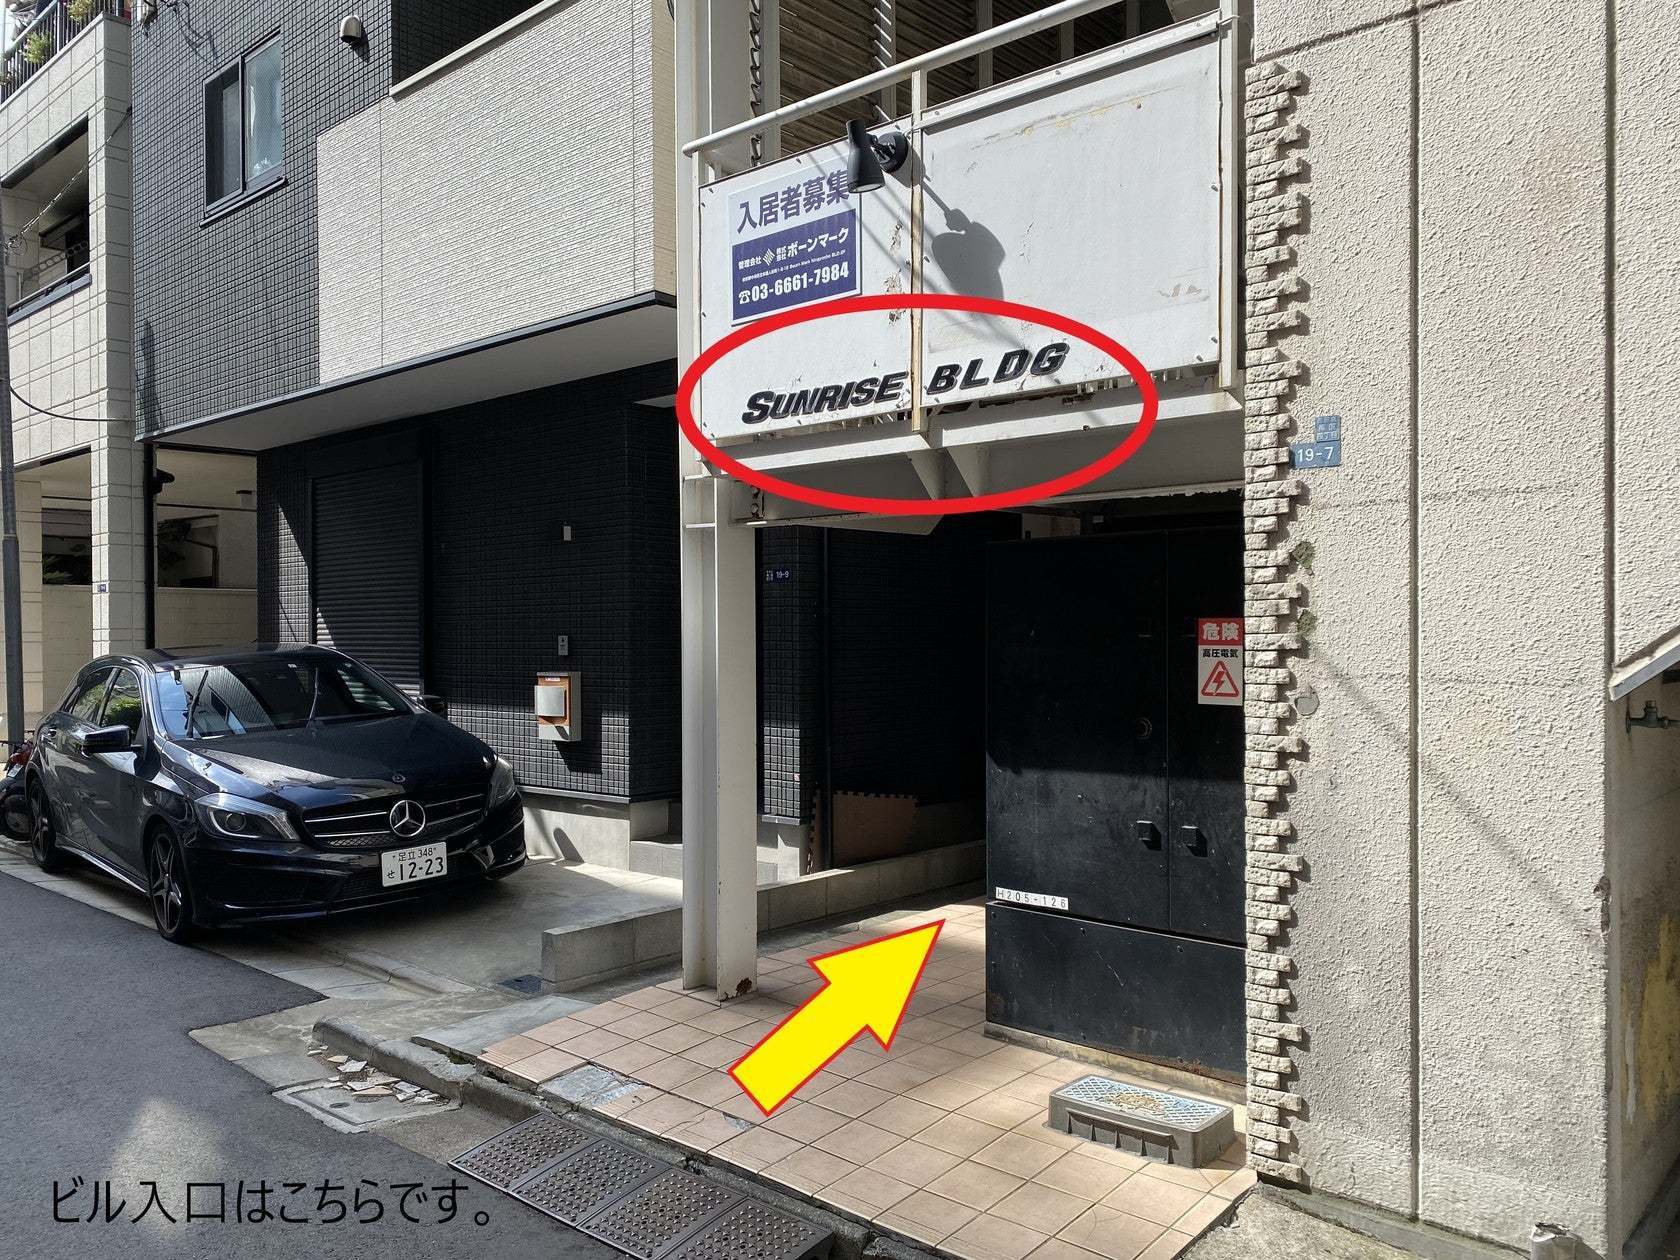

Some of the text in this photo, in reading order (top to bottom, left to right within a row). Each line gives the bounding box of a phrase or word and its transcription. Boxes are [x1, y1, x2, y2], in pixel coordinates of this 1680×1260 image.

[737, 170, 849, 234] 入居者募集
[751, 261, 849, 302] 03-6661-7984
[741, 342, 1071, 424] SUNRISE BLDG
[1297, 446, 1334, 463] 19-7
[1202, 622, 1239, 641] 危険
[1202, 648, 1239, 658] 高圧電気
[417, 847, 433, 858] 348
[400, 856, 444, 881] 12-23
[997, 888, 1067, 909] H205-126
